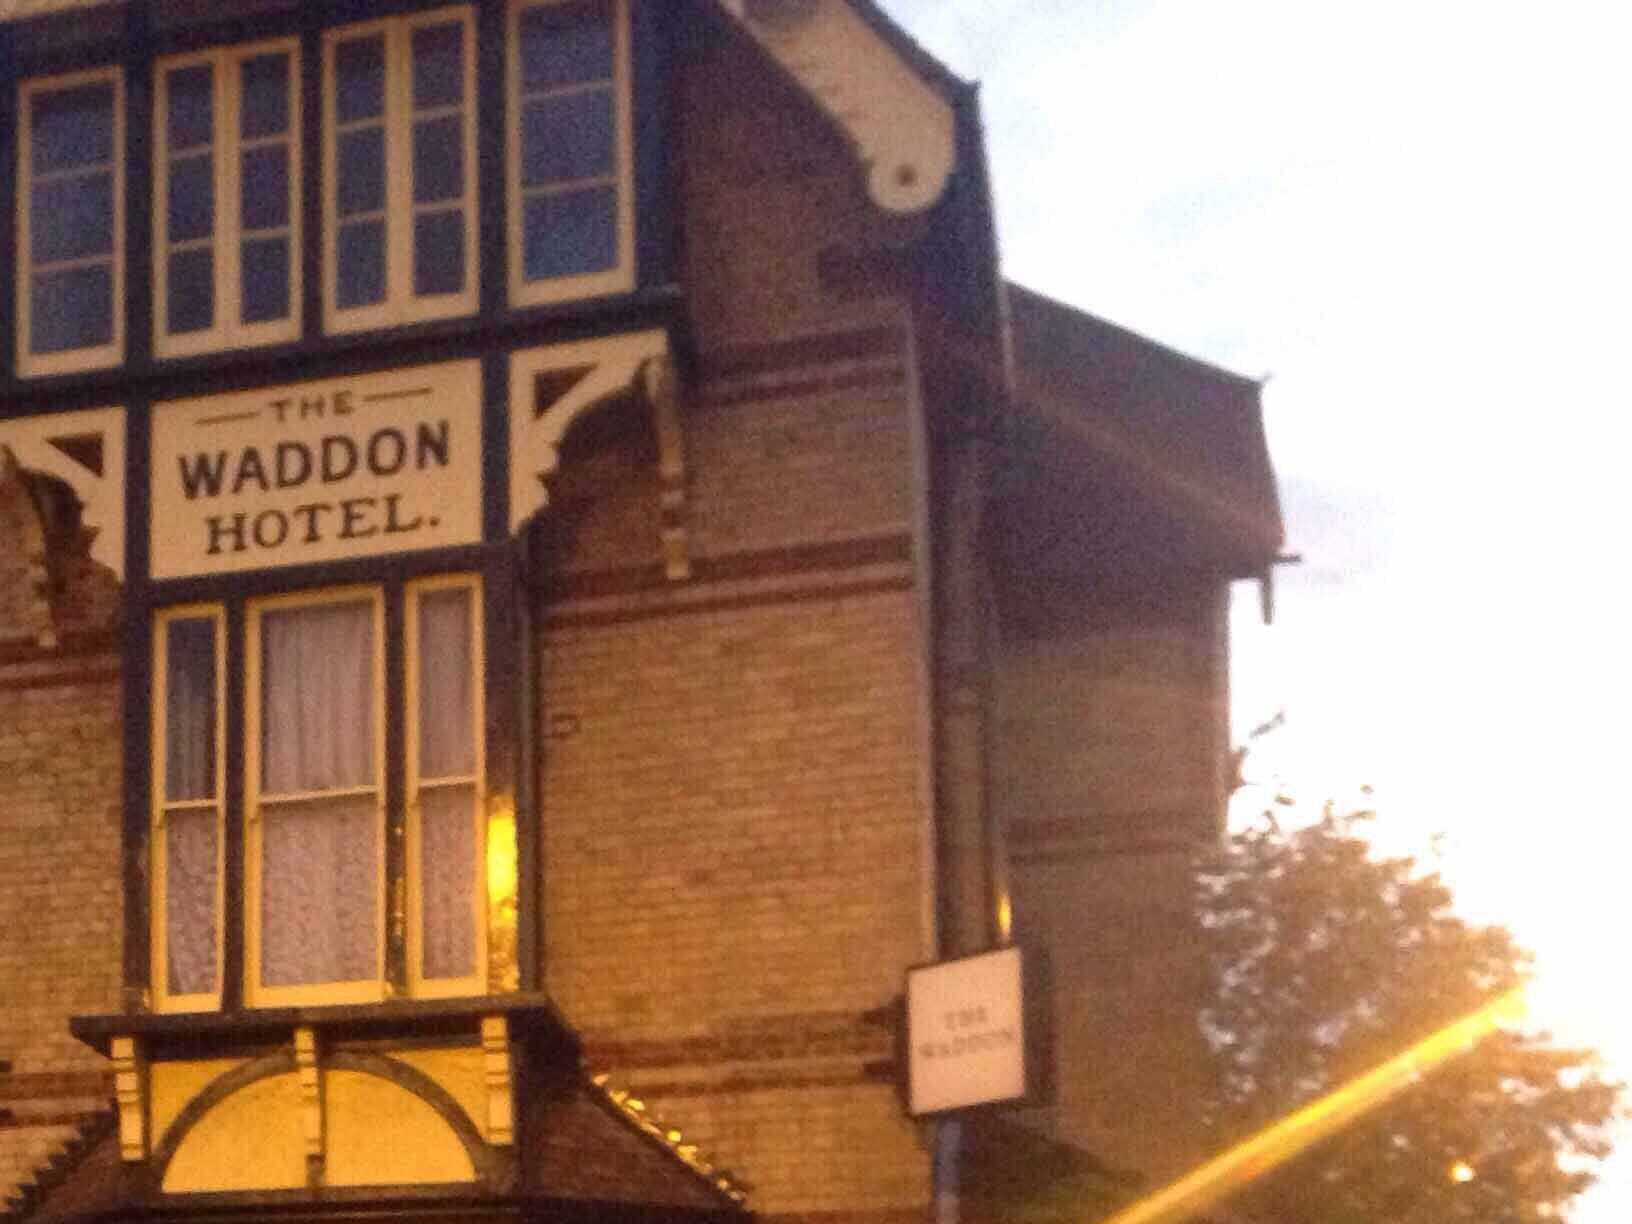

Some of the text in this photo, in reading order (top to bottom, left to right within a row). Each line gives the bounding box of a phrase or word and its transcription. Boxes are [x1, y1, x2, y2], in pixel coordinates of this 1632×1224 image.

[270, 390, 354, 422] THE
[177, 419, 449, 500] WADDON
[206, 494, 441, 554] HOTEL.
